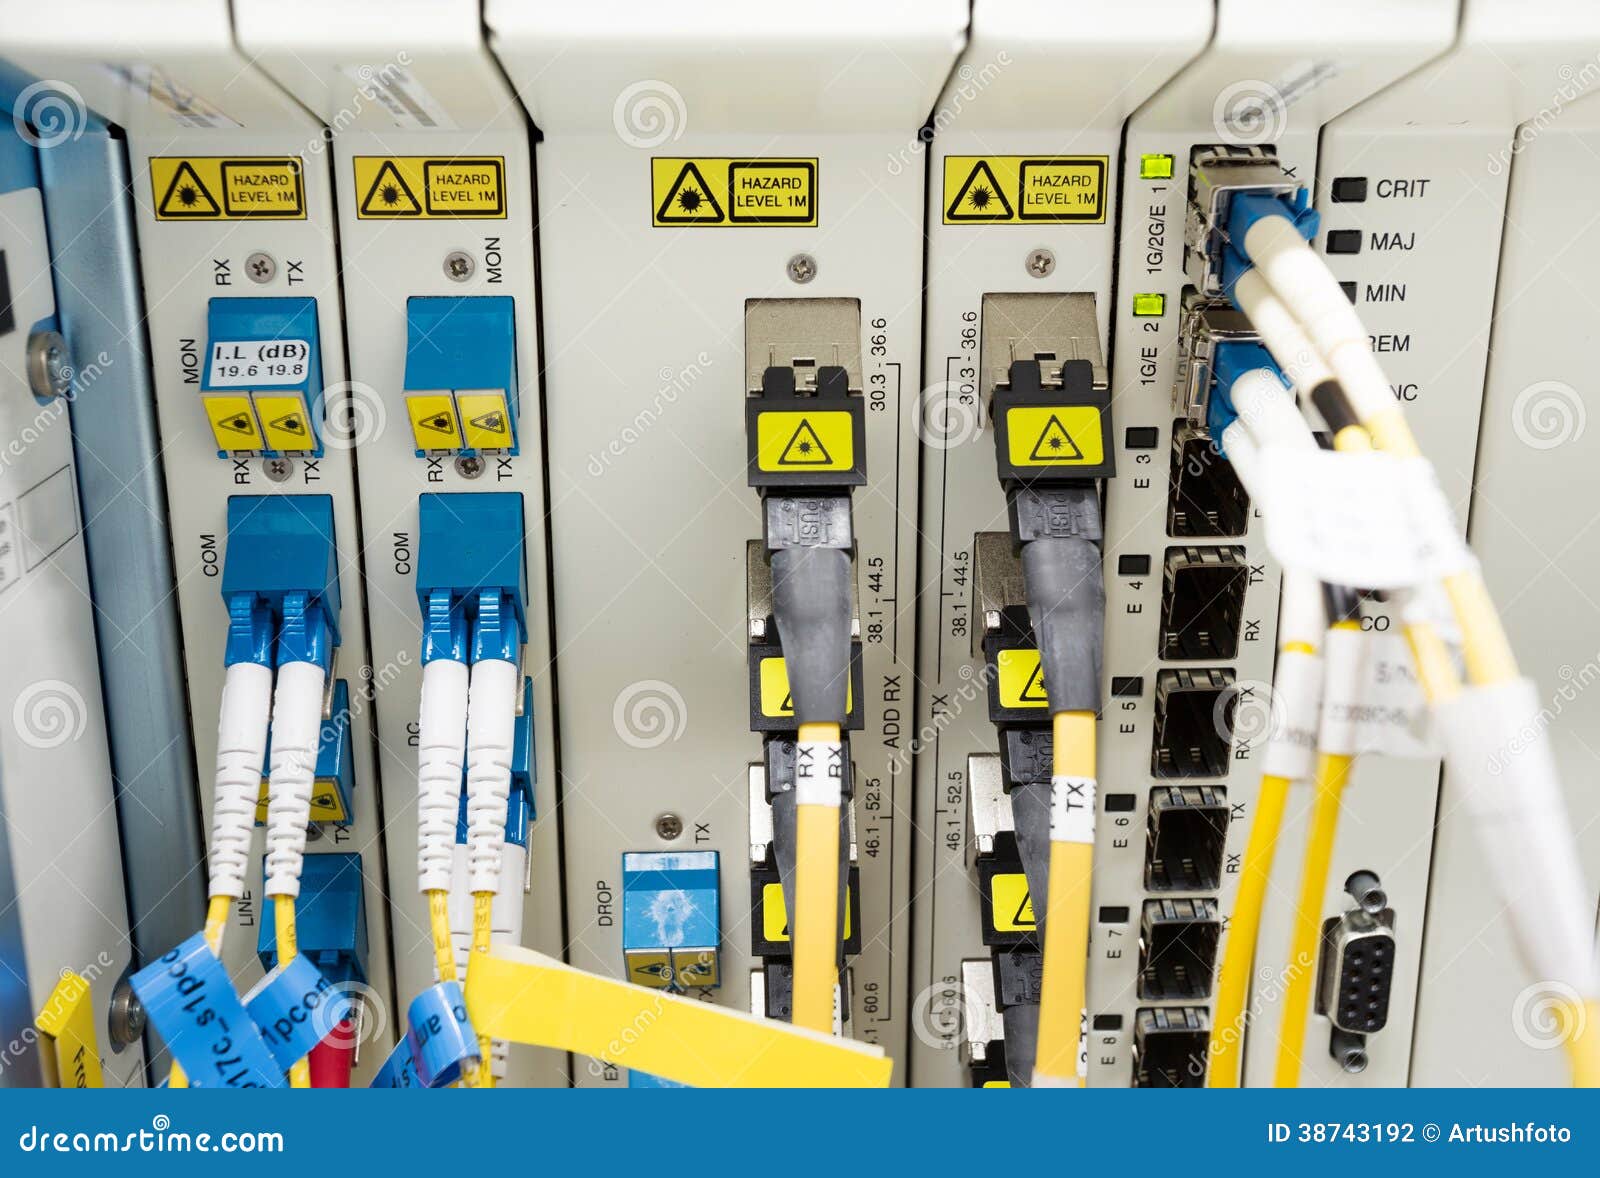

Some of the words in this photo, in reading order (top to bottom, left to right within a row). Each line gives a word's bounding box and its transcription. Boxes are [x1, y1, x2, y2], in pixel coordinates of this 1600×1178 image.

[234, 174, 289, 187] HAZARD
[436, 173, 491, 186] HAZARD
[742, 177, 802, 189] HAZARD
[1032, 175, 1091, 187] HAZARD
[1281, 166, 1297, 178] X
[231, 191, 270, 203] LEVEL
[276, 191, 295, 203] 1M
[433, 190, 474, 202] LEVEL
[478, 190, 496, 202] 1M
[1027, 193, 1071, 205] LEVEL
[1076, 193, 1096, 205] 1M
[1376, 179, 1430, 198] CRIT
[737, 196, 782, 207] LEVEL
[787, 196, 807, 207] 1M
[1147, 205, 1166, 274] 1G/2G/E
[1370, 233, 1415, 251] MAJ
[486, 237, 501, 283] MON
[216, 259, 231, 285] RX
[288, 260, 304, 285] TX
[1366, 285, 1406, 301] MIN
[871, 318, 887, 355] 36.6
[961, 311, 977, 350] 36.6
[1144, 323, 1159, 332] 2
[181, 338, 199, 384] MON
[258, 343, 307, 362] (dB)
[218, 364, 258, 378] 19.6
[267, 363, 303, 376] 19.8
[1141, 347, 1158, 385] 1G/E
[870, 374, 886, 411] 30.3
[959, 368, 975, 405] 30.3
[497, 457, 513, 481] TX
[1137, 454, 1150, 464] 3
[235, 459, 251, 484] RX
[305, 460, 320, 484] TX
[429, 458, 444, 483] RX
[1135, 478, 1150, 489] E
[200, 534, 219, 577] COM
[394, 531, 411, 575] COM
[869, 557, 883, 592] 44.5
[954, 551, 969, 587] 44.5
[1249, 564, 1265, 586] TX
[1130, 581, 1143, 590] 4
[952, 604, 967, 636] 38.1
[1128, 604, 1142, 614] E
[868, 607, 883, 643] 38.1
[1245, 619, 1260, 641] RX
[1359, 616, 1390, 632] CO
[884, 675, 900, 701] RX
[1240, 686, 1255, 705] TX
[932, 694, 948, 718] TX
[1123, 702, 1136, 711] 5
[884, 702, 900, 748] ADD
[1121, 723, 1135, 734] E
[1235, 739, 1250, 760] RX
[799, 747, 814, 778] RX
[866, 778, 881, 811] 52.5
[948, 771, 963, 805] 52.5
[1066, 783, 1085, 812] TX
[1115, 817, 1129, 826] 6
[1231, 802, 1246, 822] TX
[335, 823, 350, 844] TX
[695, 823, 710, 844] TX
[866, 822, 881, 857] 46.1
[947, 816, 961, 851] 46.1
[1114, 838, 1128, 848] E
[1226, 853, 1241, 873] RX
[238, 890, 254, 927] LINE
[597, 880, 612, 927] DROP
[1109, 930, 1122, 938] 7
[1107, 950, 1122, 959] E
[864, 982, 878, 1013] 60.6
[1101, 1056, 1115, 1065] E
